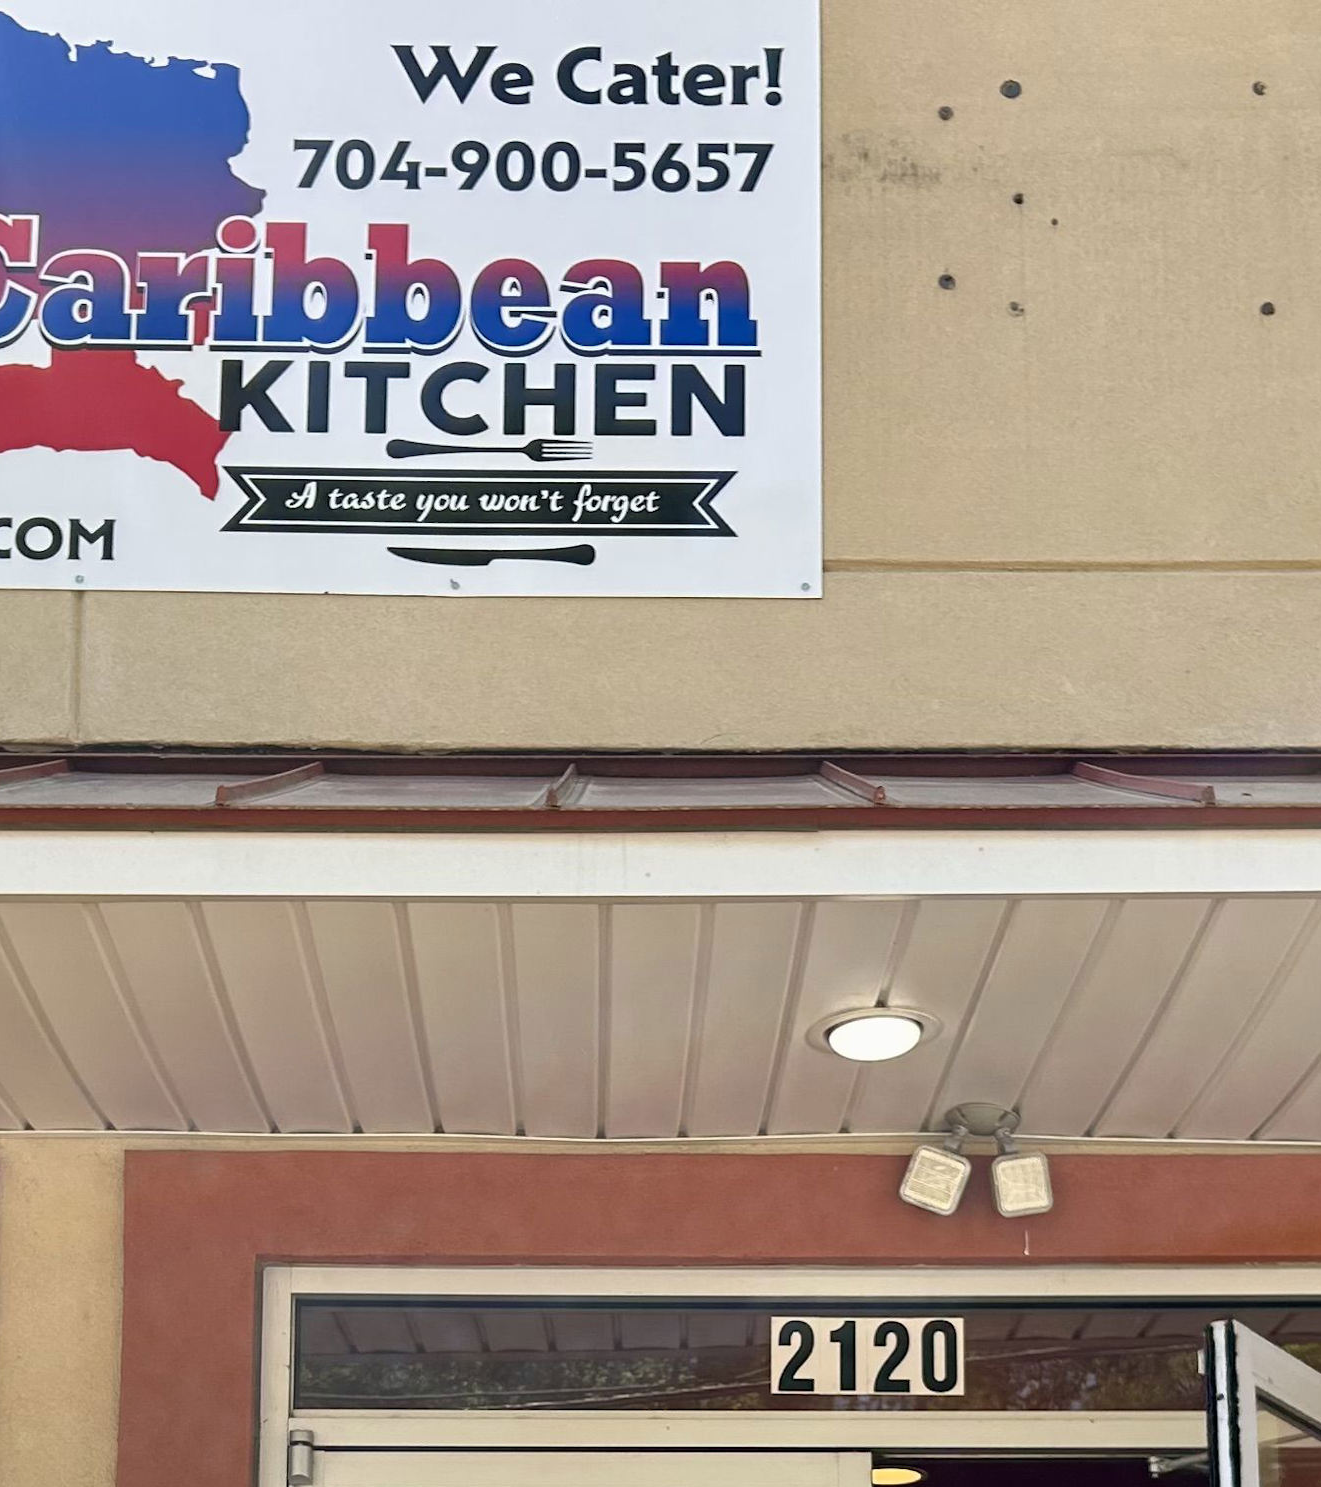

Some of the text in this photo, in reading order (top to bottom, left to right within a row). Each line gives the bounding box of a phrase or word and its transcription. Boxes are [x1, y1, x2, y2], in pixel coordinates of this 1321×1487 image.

[390, 45, 785, 106] We Cater!
[293, 139, 774, 192] 704-900-5657
[220, 359, 746, 437] KITCHEN
[285, 481, 661, 522] A taste you won't forget
[778, 1319, 958, 1393] 2120
